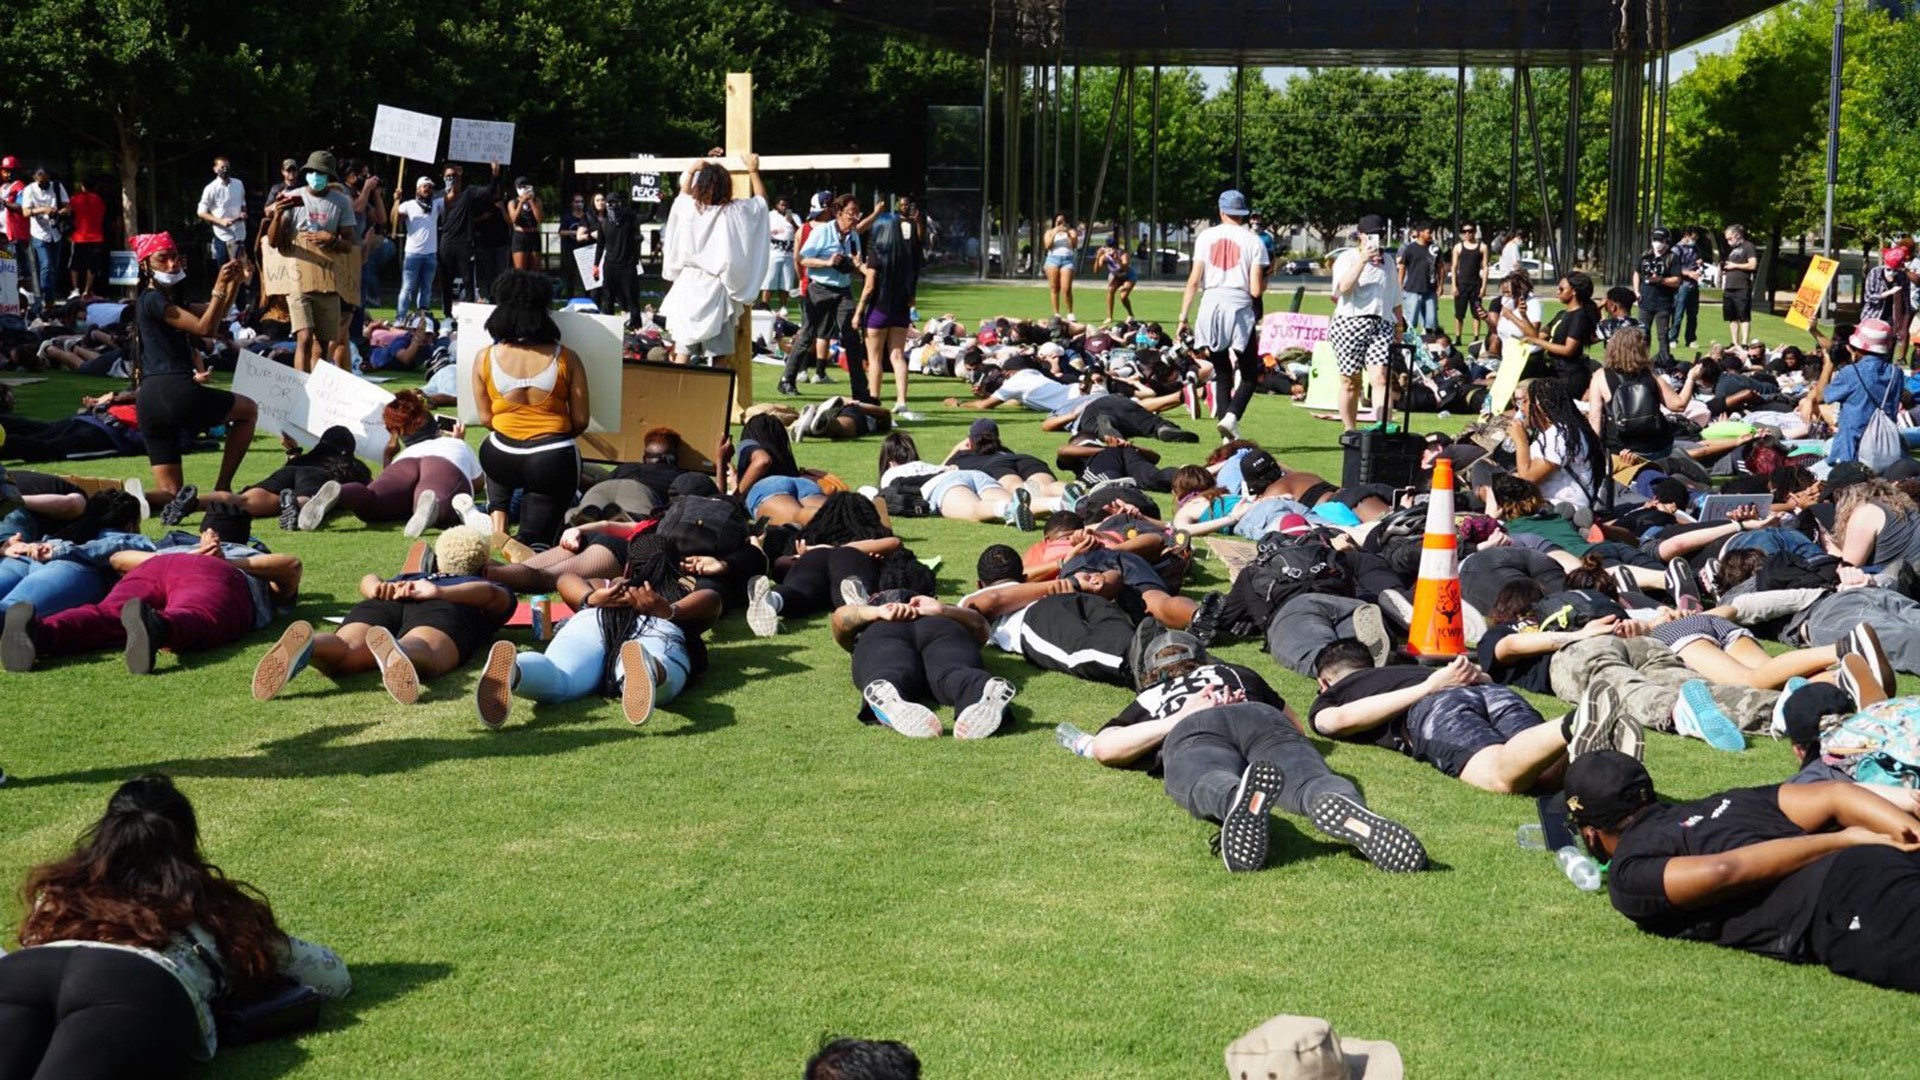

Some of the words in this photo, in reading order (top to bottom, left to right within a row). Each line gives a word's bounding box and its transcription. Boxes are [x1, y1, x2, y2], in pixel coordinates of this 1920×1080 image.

[640, 175, 655, 187] NO
[632, 185, 660, 199] PEACE
[267, 265, 303, 282] WAS
[1270, 325, 1327, 341] JUSTICE
[270, 384, 292, 402] OR
